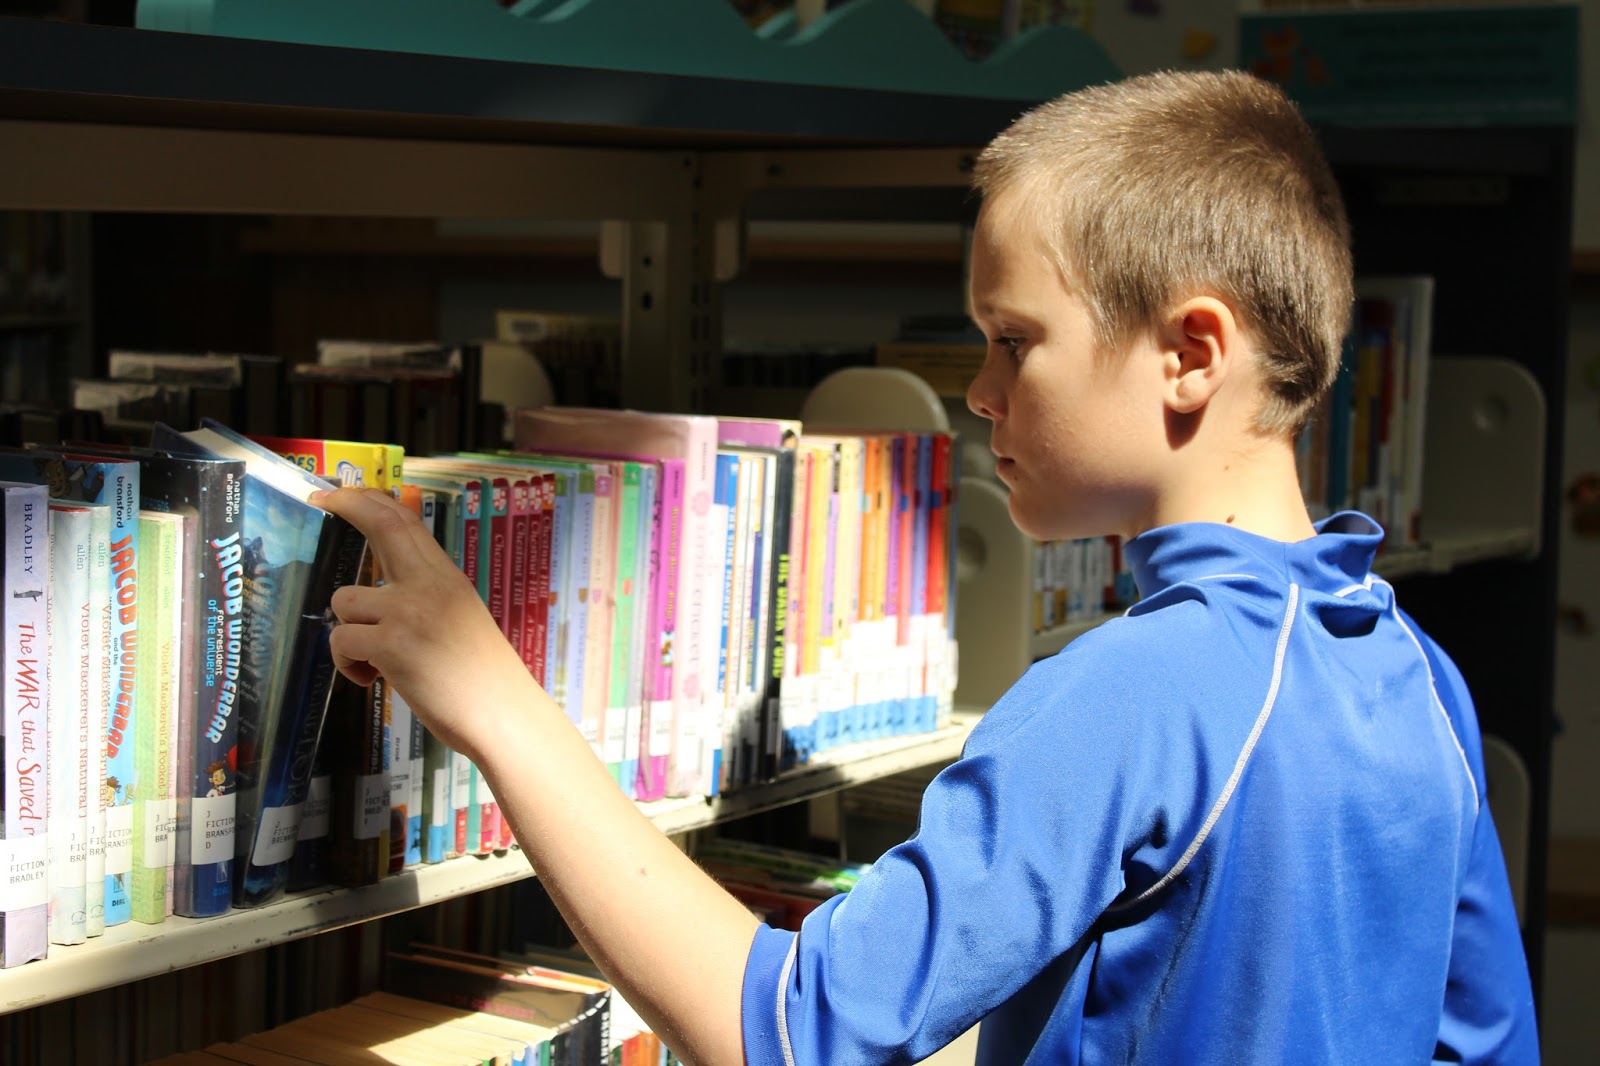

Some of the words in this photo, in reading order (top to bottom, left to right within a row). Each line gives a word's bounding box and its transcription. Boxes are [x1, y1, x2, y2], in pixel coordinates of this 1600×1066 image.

[115, 475, 125, 529] bransford
[126, 482, 134, 521] nathan
[24, 503, 33, 575] BRADLEY
[97, 542, 107, 568] allen
[514, 521, 525, 577] Chestnut
[528, 520, 539, 576] Chestnut
[540, 515, 551, 570] Chestnut
[76, 544, 86, 571] allen
[209, 531, 243, 615] JACOB
[493, 533, 505, 589] Chestnut
[110, 533, 139, 626] JACOB
[513, 580, 525, 606] Hill
[527, 579, 538, 604] Hill
[539, 574, 549, 599] Hill
[208, 599, 217, 612] of
[492, 593, 504, 618] Hill
[18, 621, 36, 656] The
[80, 601, 91, 650] Violet
[101, 603, 110, 650] Violet
[207, 616, 218, 635] the
[161, 642, 169, 677] Violet
[206, 637, 217, 687] universe
[14, 658, 41, 716] WAR
[202, 618, 243, 744] WONDERBAR
[374, 681, 382, 698] AN
[79, 655, 89, 743] Mackerel's
[159, 681, 168, 746] Mackerel's
[21, 719, 38, 754] that
[78, 748, 88, 811] Natural
[158, 750, 167, 789] Pocket
[16, 757, 43, 821] Saved
[107, 828, 132, 838] ICTION
[156, 814, 160, 822] J
[206, 817, 235, 828] FICTION
[71, 833, 75, 841] J
[205, 841, 211, 849] D
[10, 853, 15, 862] J
[10, 859, 45, 873] FICTION
[9, 870, 45, 884] BRADLEY
[111, 898, 126, 907] DIAL
